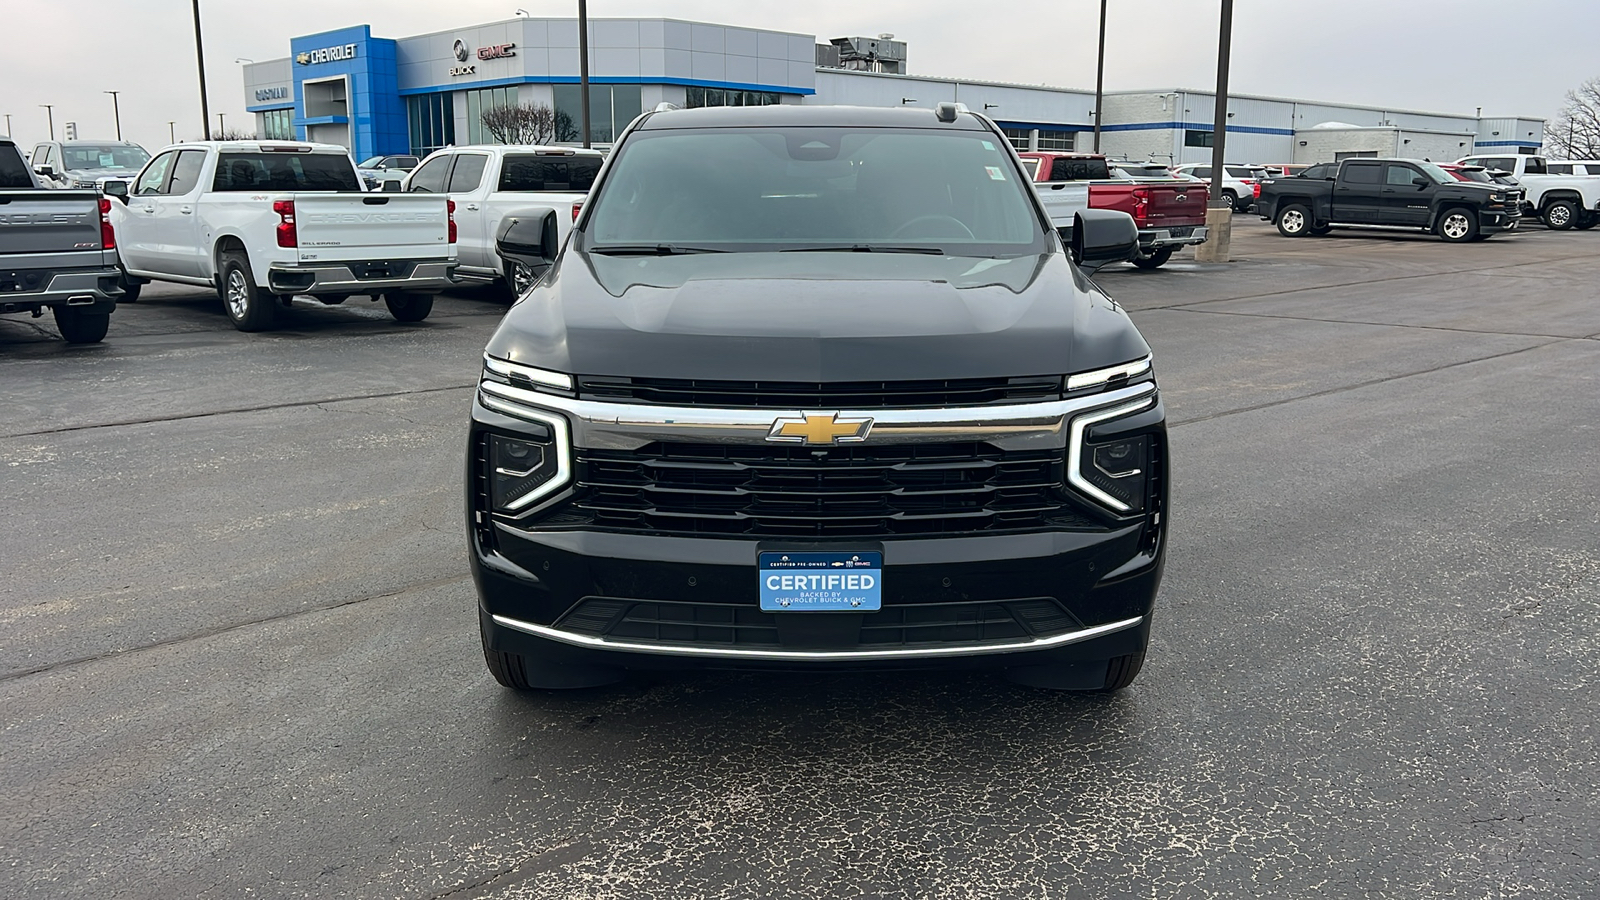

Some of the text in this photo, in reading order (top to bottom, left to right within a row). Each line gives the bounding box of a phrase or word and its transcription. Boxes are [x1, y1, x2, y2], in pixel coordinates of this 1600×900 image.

[310, 43, 357, 64] CHEVROLET
[477, 43, 515, 60] GMC
[449, 65, 475, 76] BUICK
[309, 212, 440, 224] CHEVROLET
[766, 575, 875, 591] CERTIFIED
